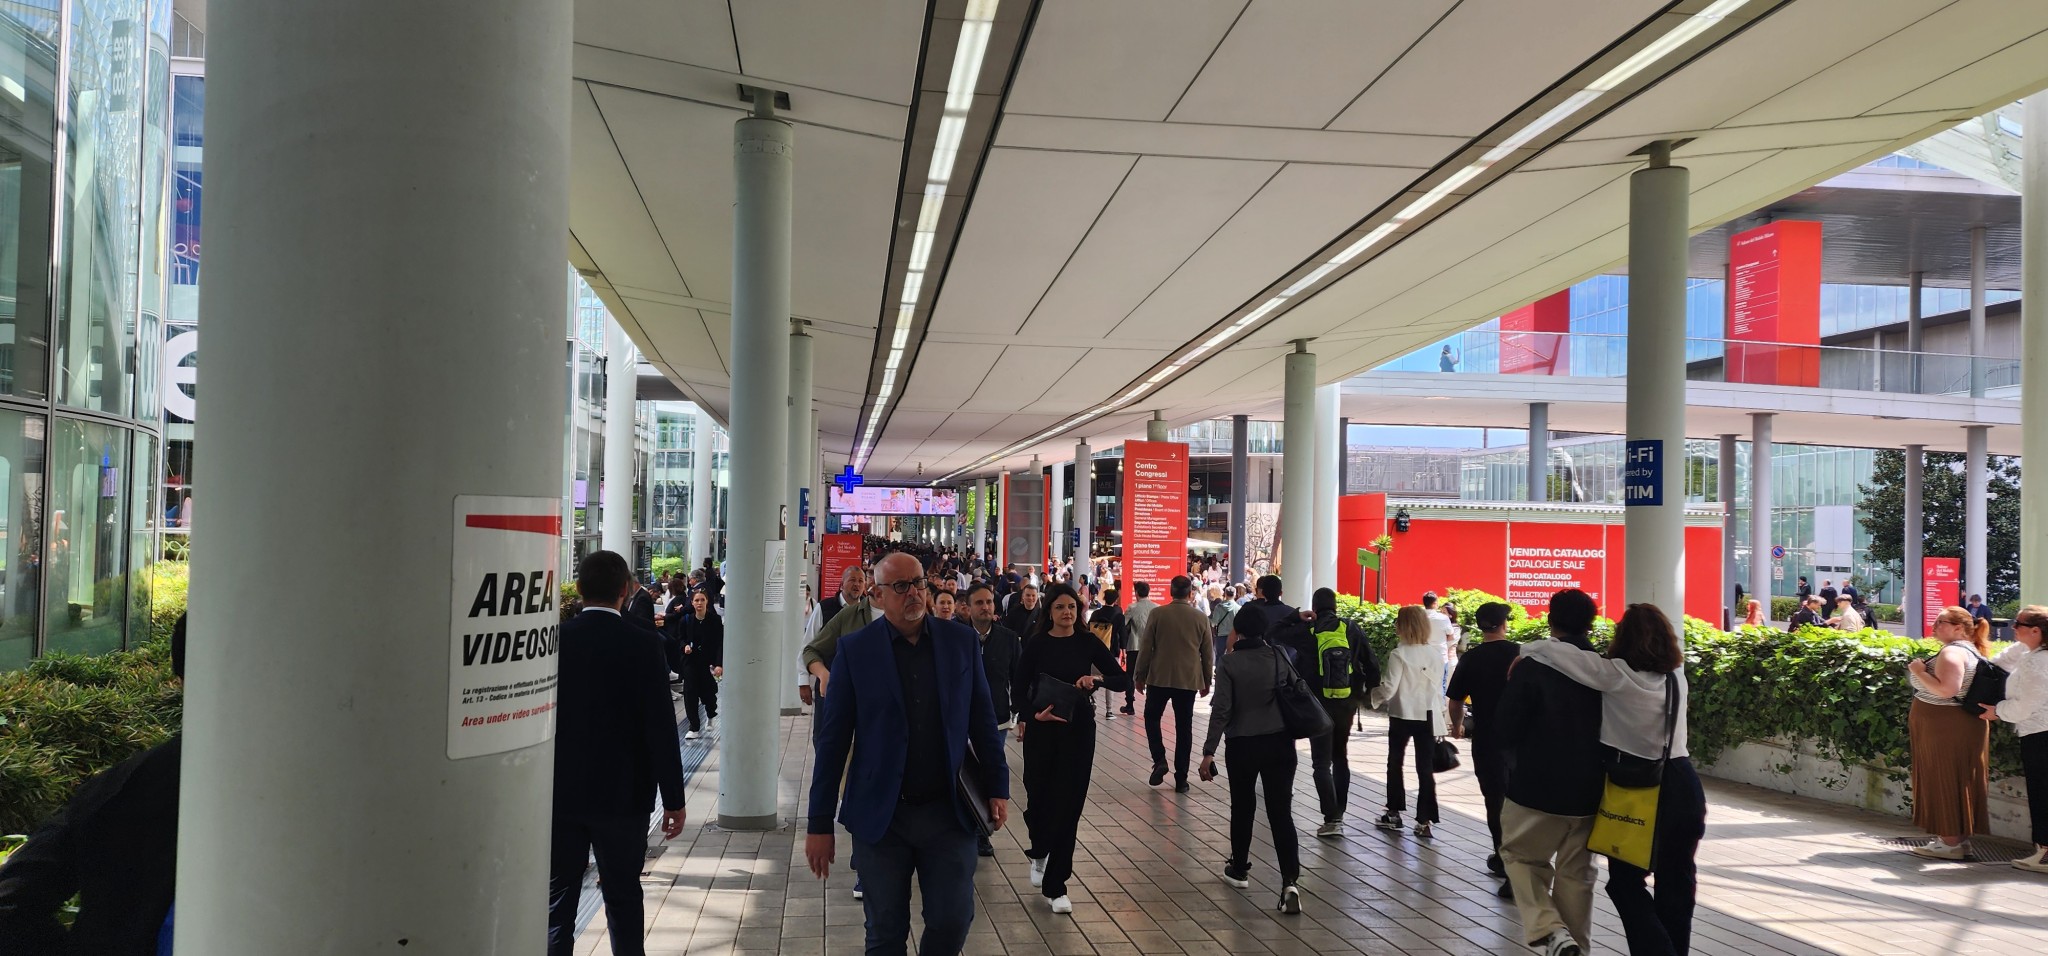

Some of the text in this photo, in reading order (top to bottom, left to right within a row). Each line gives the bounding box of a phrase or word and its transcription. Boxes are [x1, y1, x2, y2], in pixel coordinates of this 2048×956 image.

[1627, 446, 1653, 463] i-Fi
[1135, 470, 1168, 478] Congressi
[1626, 468, 1653, 478] ered by
[1627, 485, 1653, 499] TIM
[1509, 548, 1606, 558] VENDITA CATALOGO
[1509, 559, 1585, 569] CATALOGUE SALE
[468, 570, 553, 617] AREA
[472, 685, 508, 695] registrazione
[489, 693, 507, 701] Codice
[462, 716, 484, 727] Area
[487, 713, 510, 723] under
[512, 709, 529, 720] video
